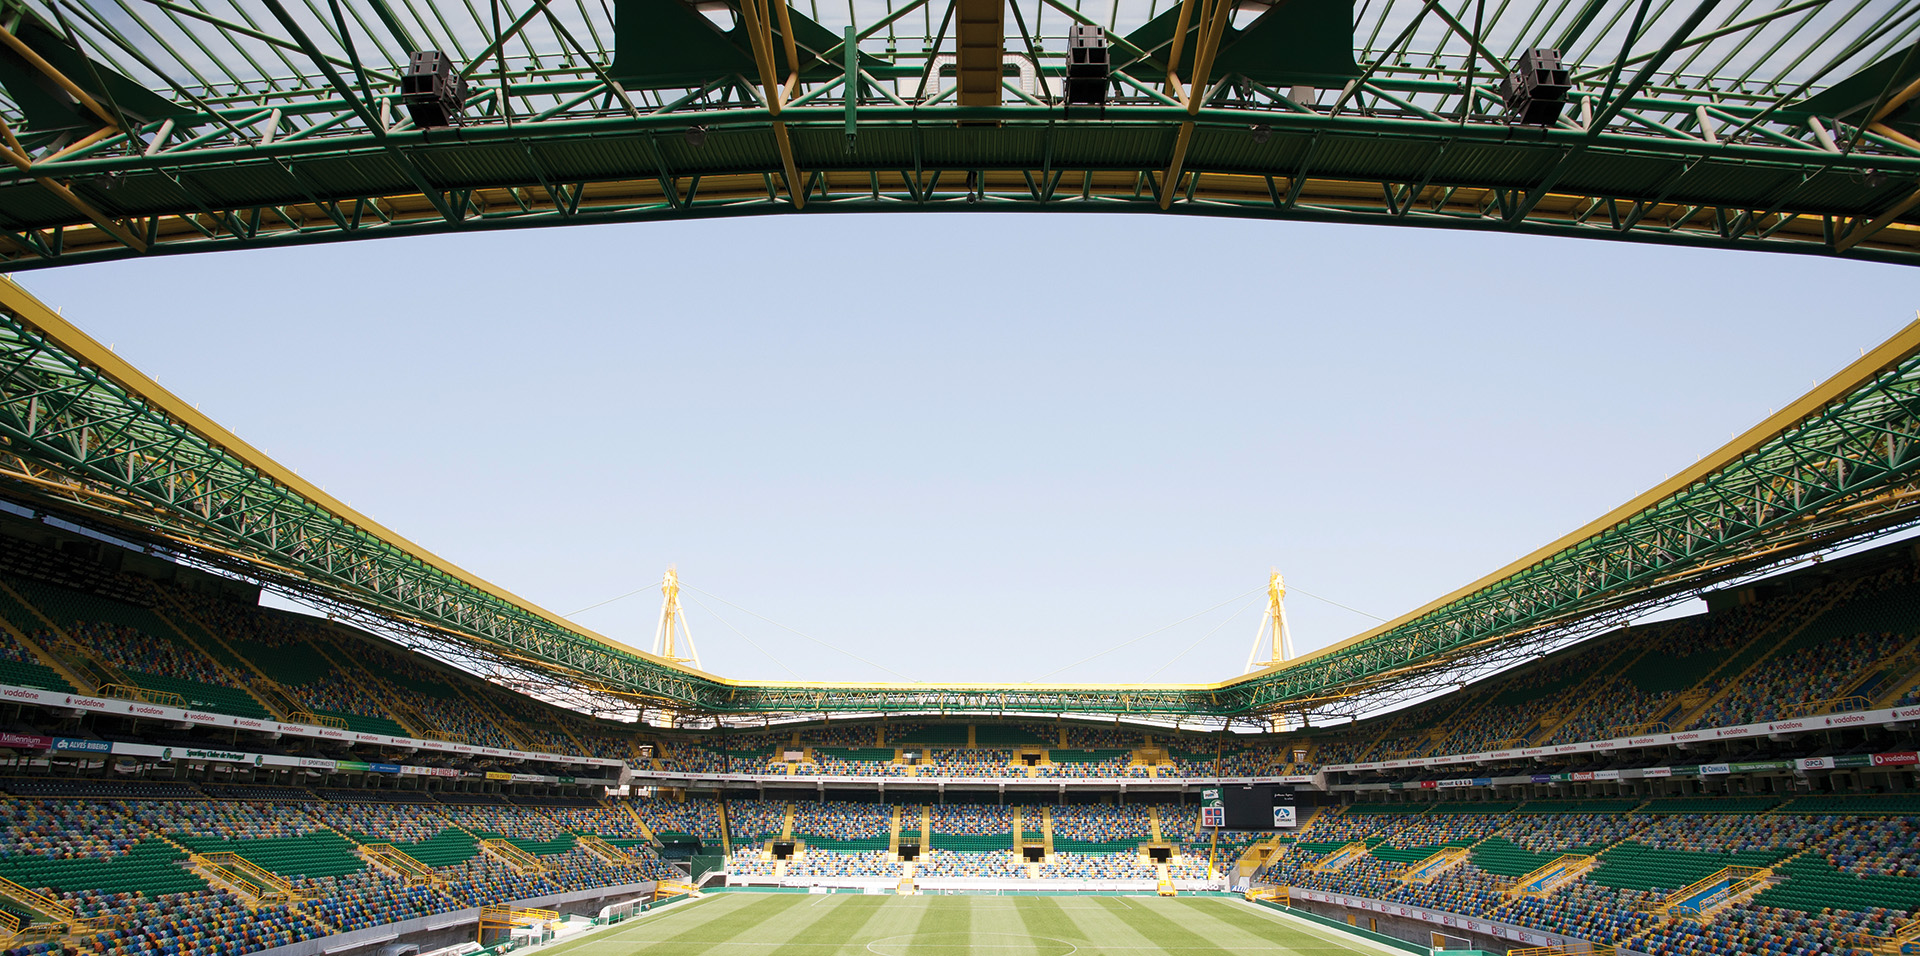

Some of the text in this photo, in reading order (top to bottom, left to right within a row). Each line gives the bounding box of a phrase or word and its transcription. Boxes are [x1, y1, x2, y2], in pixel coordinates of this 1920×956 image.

[4, 689, 39, 699] vodafone
[74, 698, 105, 708] vodafone
[136, 706, 164, 715] vodafone
[190, 713, 215, 722] vodafone
[1833, 715, 1865, 724] vodafone
[239, 719, 262, 727] vodafone
[1775, 721, 1803, 730] vodafone
[283, 725, 304, 733] vodafone
[1723, 727, 1748, 736] vodafone
[1, 733, 41, 744] Millennium
[69, 741, 87, 749] ALVES
[87, 742, 109, 751] RIBEIRO
[187, 749, 206, 758] Sporting
[207, 750, 220, 758] Clube
[226, 752, 245, 761] Portugal
[1884, 754, 1916, 762] vodafone
[1574, 772, 1592, 781] Record
